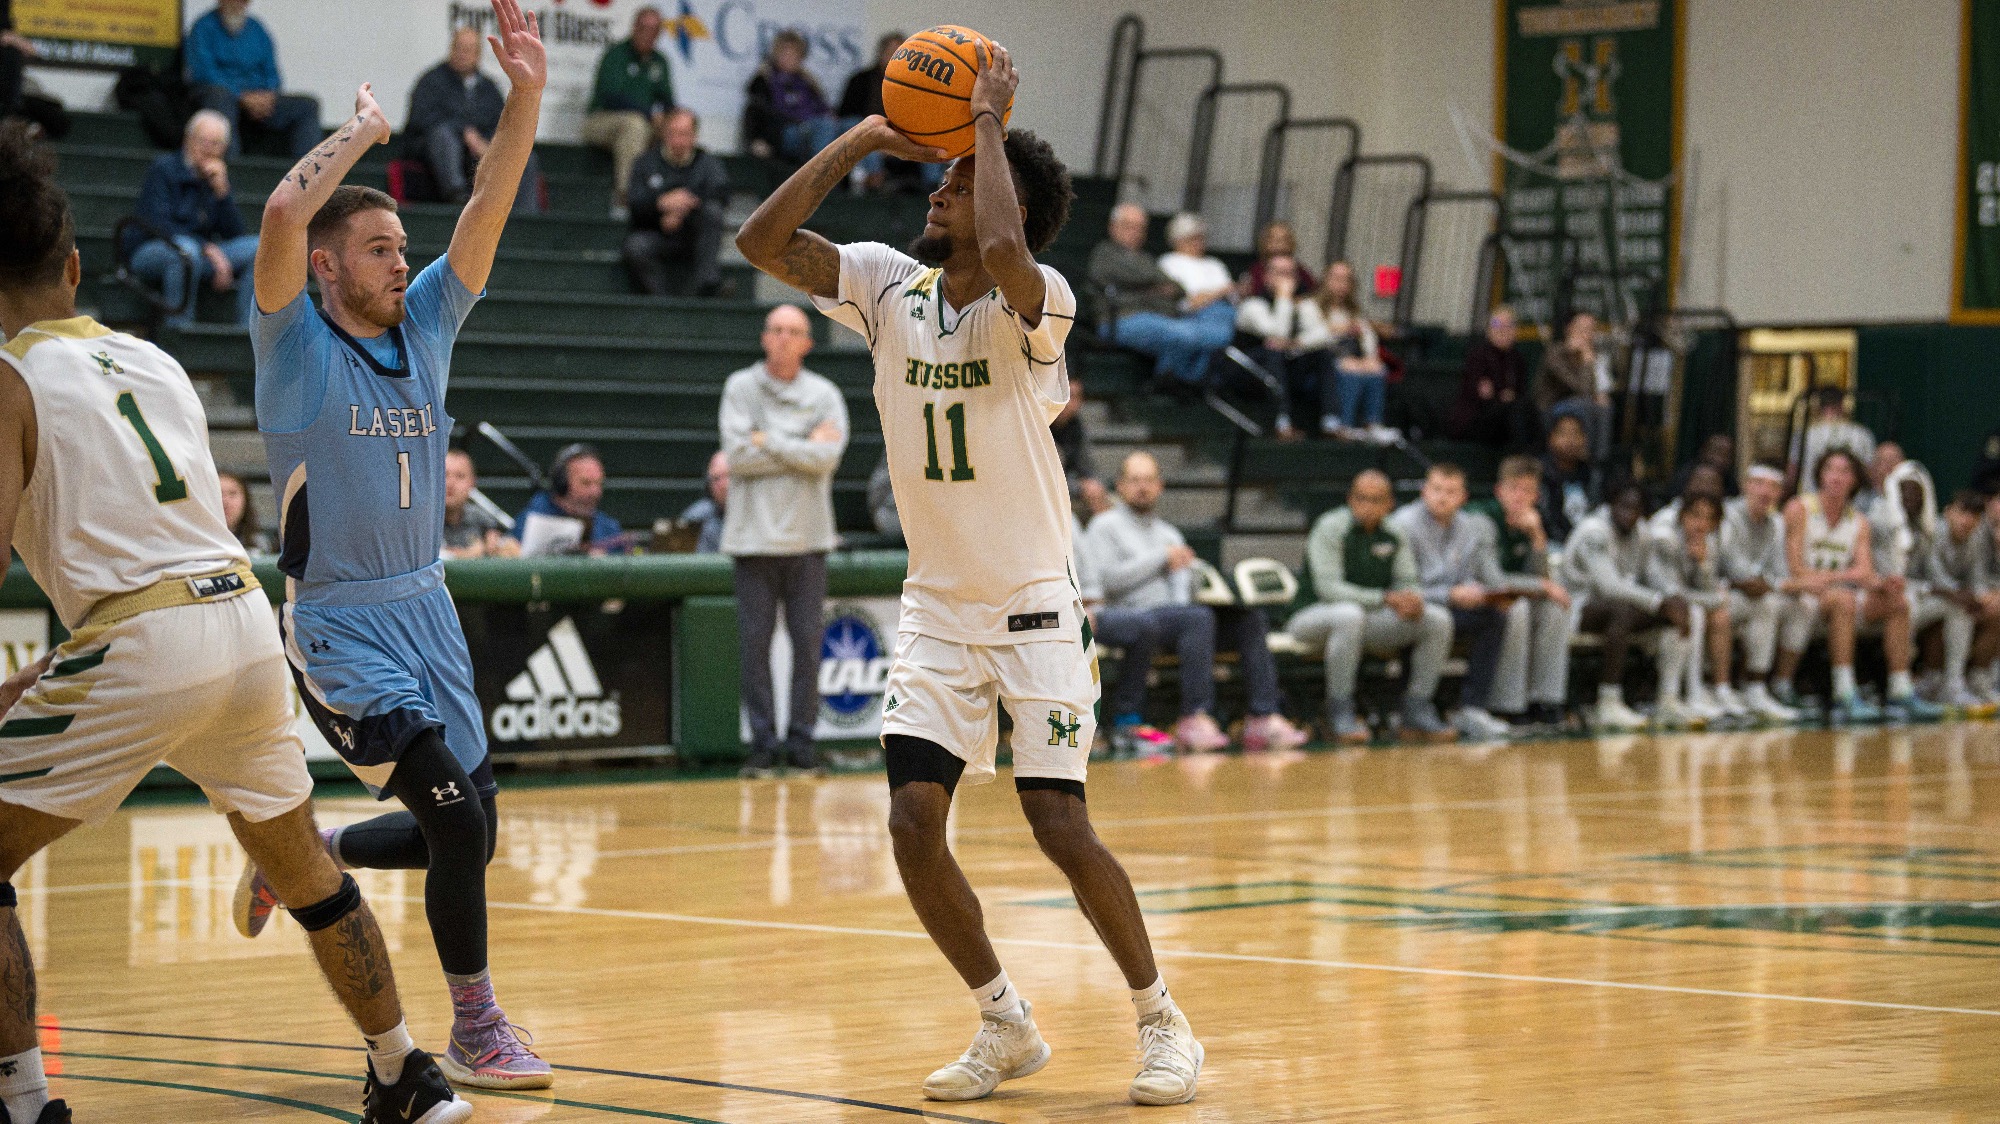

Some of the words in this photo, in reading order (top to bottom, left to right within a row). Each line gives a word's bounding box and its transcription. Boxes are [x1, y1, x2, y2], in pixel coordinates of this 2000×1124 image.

[905, 357, 992, 390] HUSSON
[114, 389, 190, 506] 1
[923, 401, 976, 482] 11
[396, 451, 412, 510] 1
[490, 694, 622, 741] adidas
